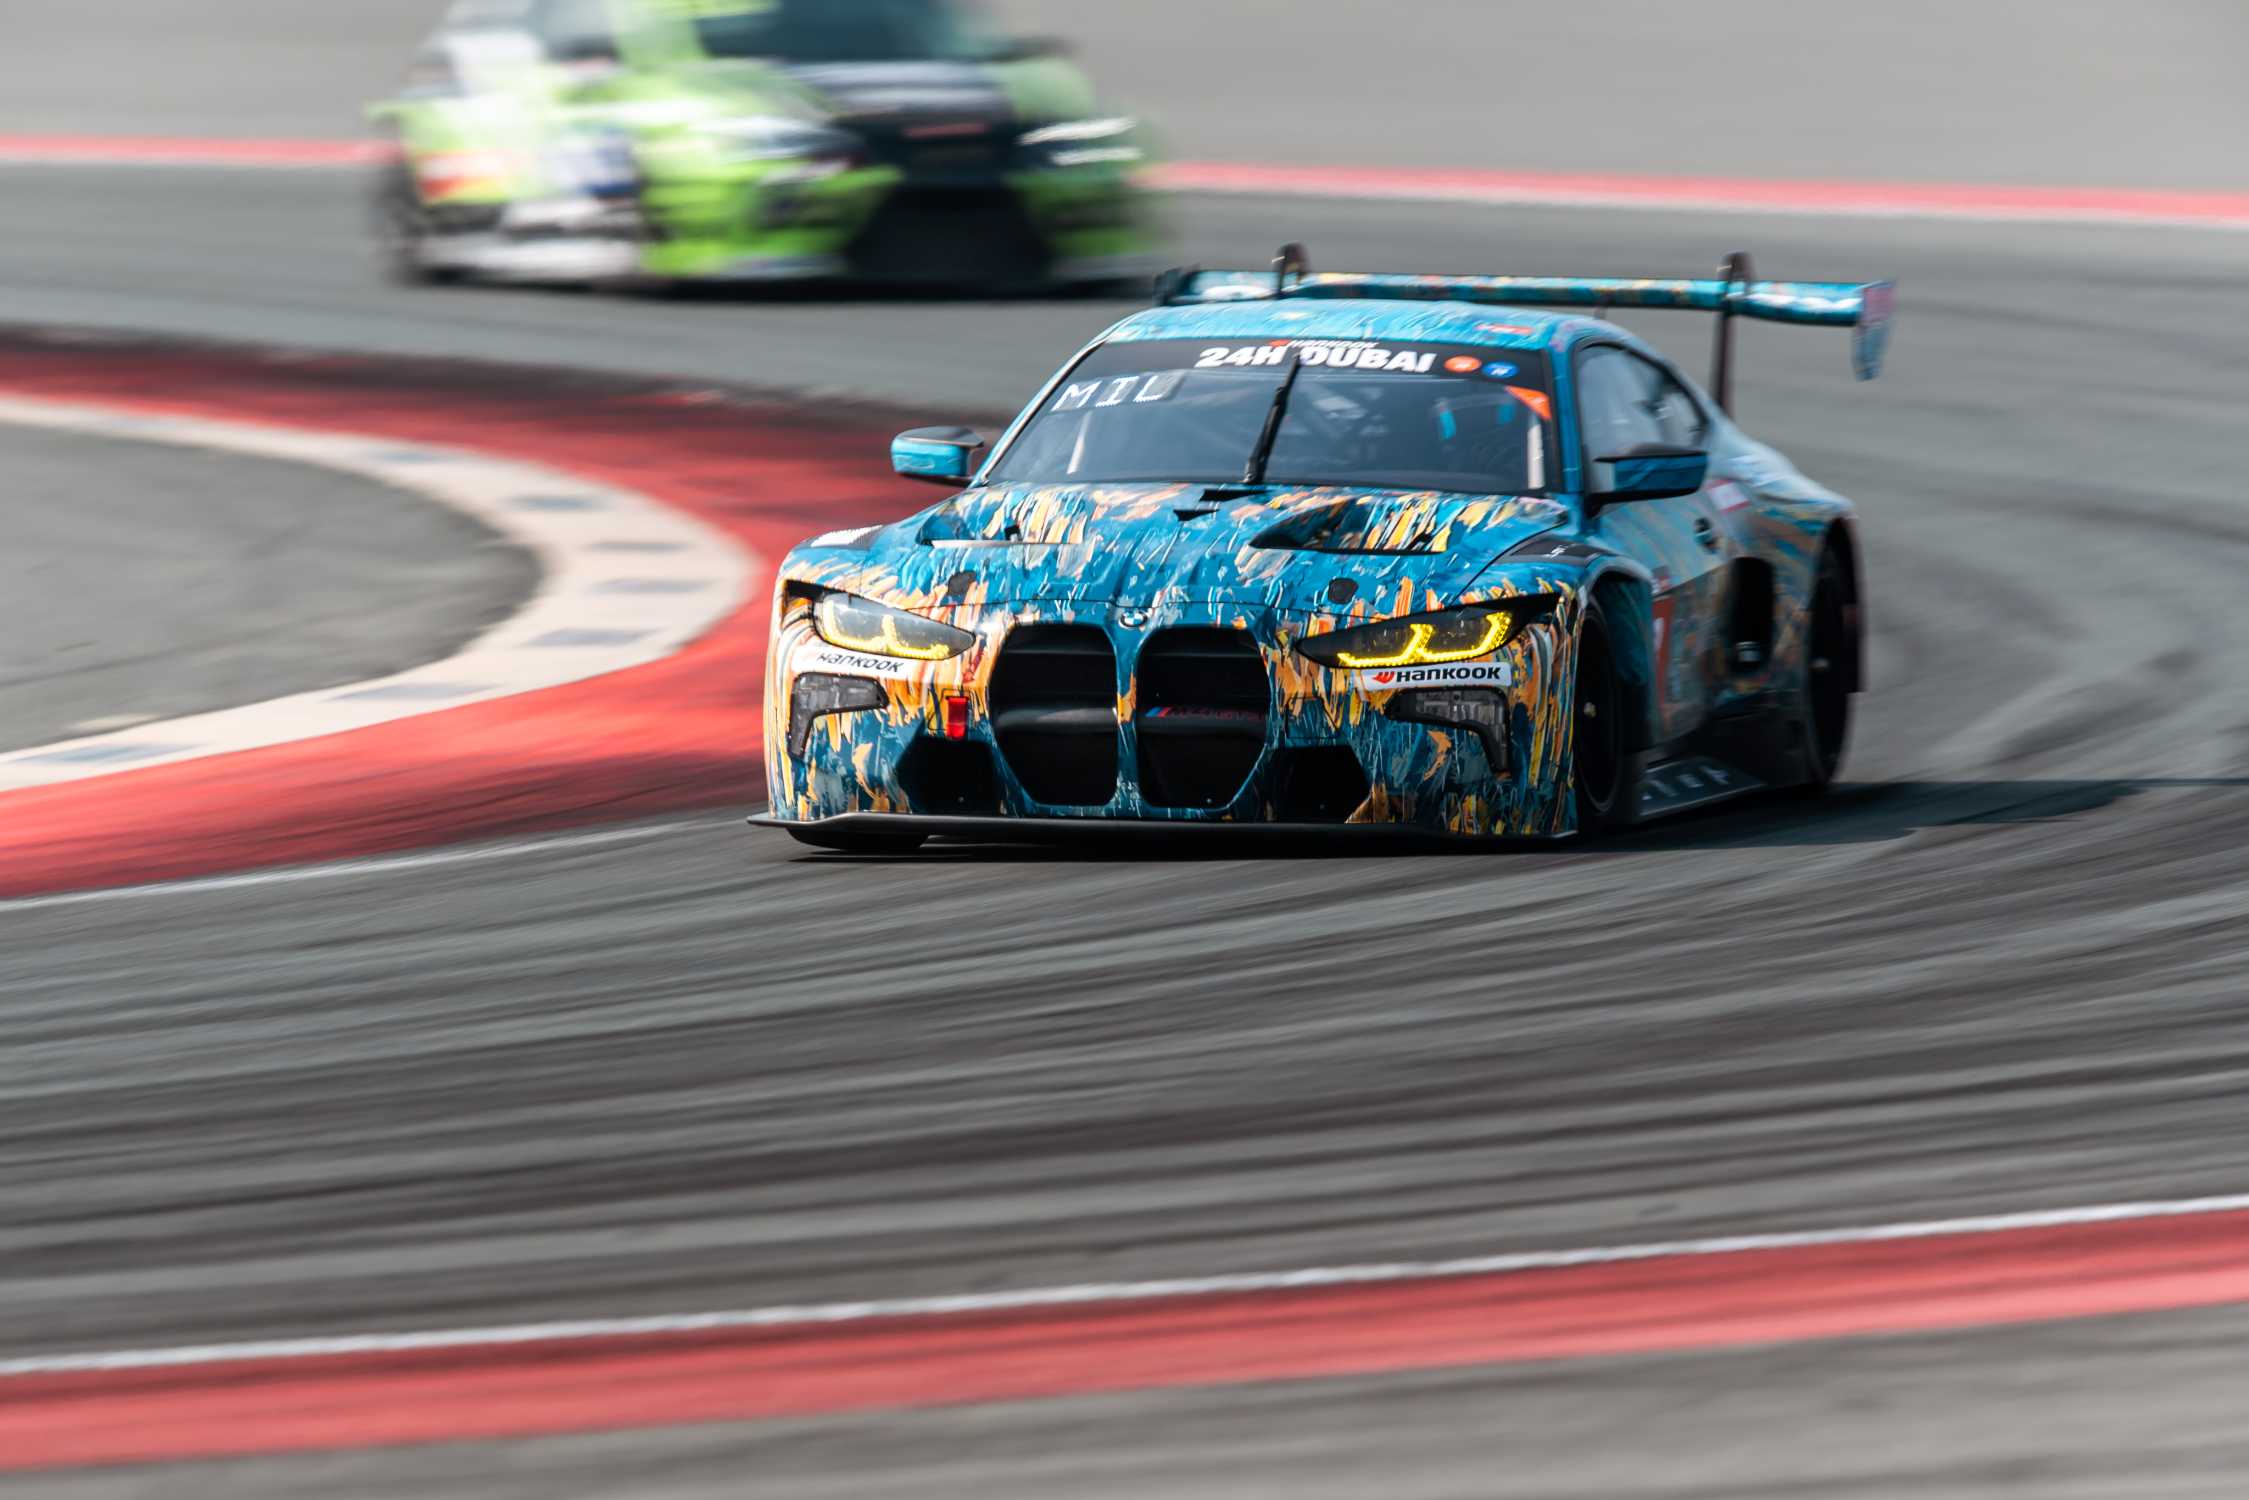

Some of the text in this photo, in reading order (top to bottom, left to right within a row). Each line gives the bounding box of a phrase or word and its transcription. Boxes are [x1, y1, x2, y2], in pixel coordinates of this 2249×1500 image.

[1195, 346, 1288, 368] 24H
[1297, 347, 1437, 372] DUBAI
[1051, 375, 1163, 411] MIL
